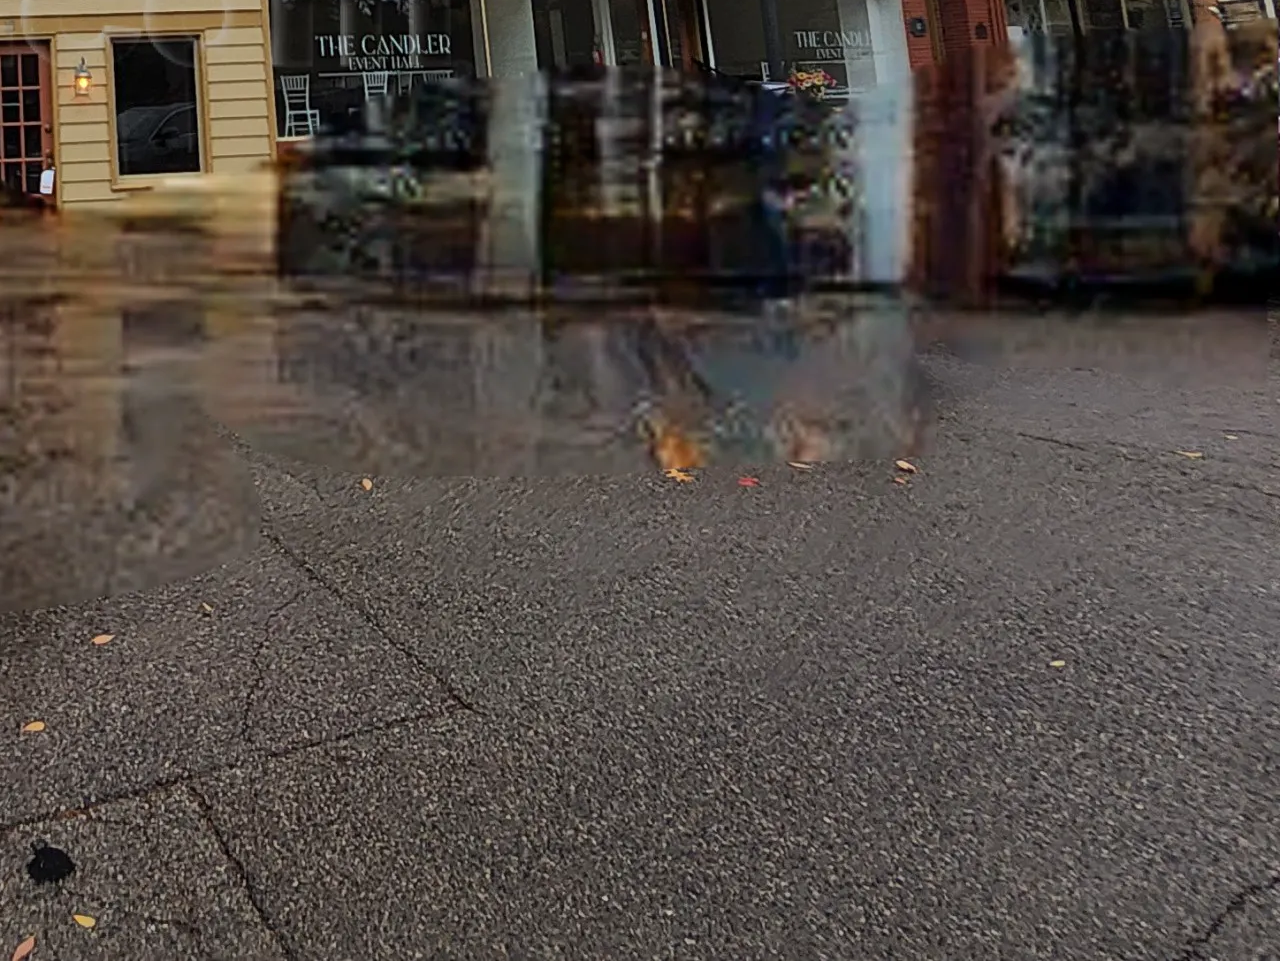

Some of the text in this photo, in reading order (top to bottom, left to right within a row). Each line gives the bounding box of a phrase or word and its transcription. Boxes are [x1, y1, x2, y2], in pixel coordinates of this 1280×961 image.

[314, 32, 452, 57] THE CANDLER
[793, 30, 821, 48] THE
[348, 56, 425, 71] EVENT HALL
